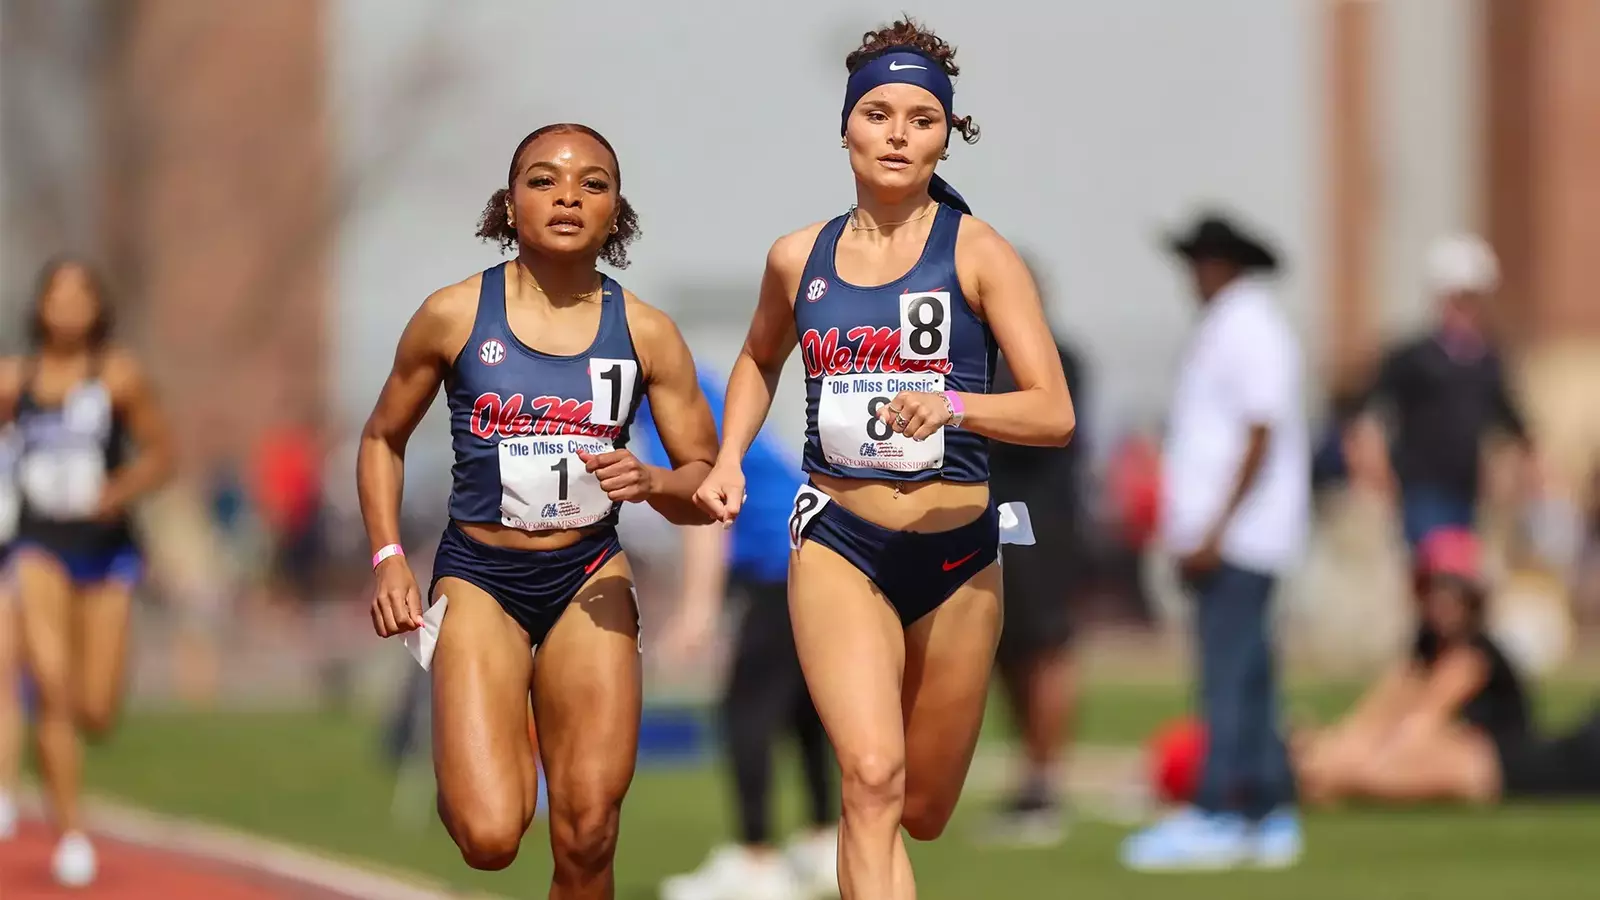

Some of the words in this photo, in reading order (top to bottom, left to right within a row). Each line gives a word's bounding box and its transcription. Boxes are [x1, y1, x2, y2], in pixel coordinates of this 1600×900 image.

[807, 278, 827, 301] SEC
[907, 295, 945, 356] 8
[480, 339, 504, 364] SEC
[801, 327, 854, 378] Ole
[600, 363, 622, 422] 1
[832, 380, 849, 395] Ole
[853, 378, 883, 394] Miss
[887, 378, 934, 394] Classic
[469, 392, 533, 440] Ole
[866, 396, 894, 441] 8
[509, 442, 529, 457] Ole
[533, 441, 564, 456] Miss
[567, 439, 605, 455] Classic
[877, 460, 930, 471] MISSISSIPPI
[550, 457, 569, 501] 1
